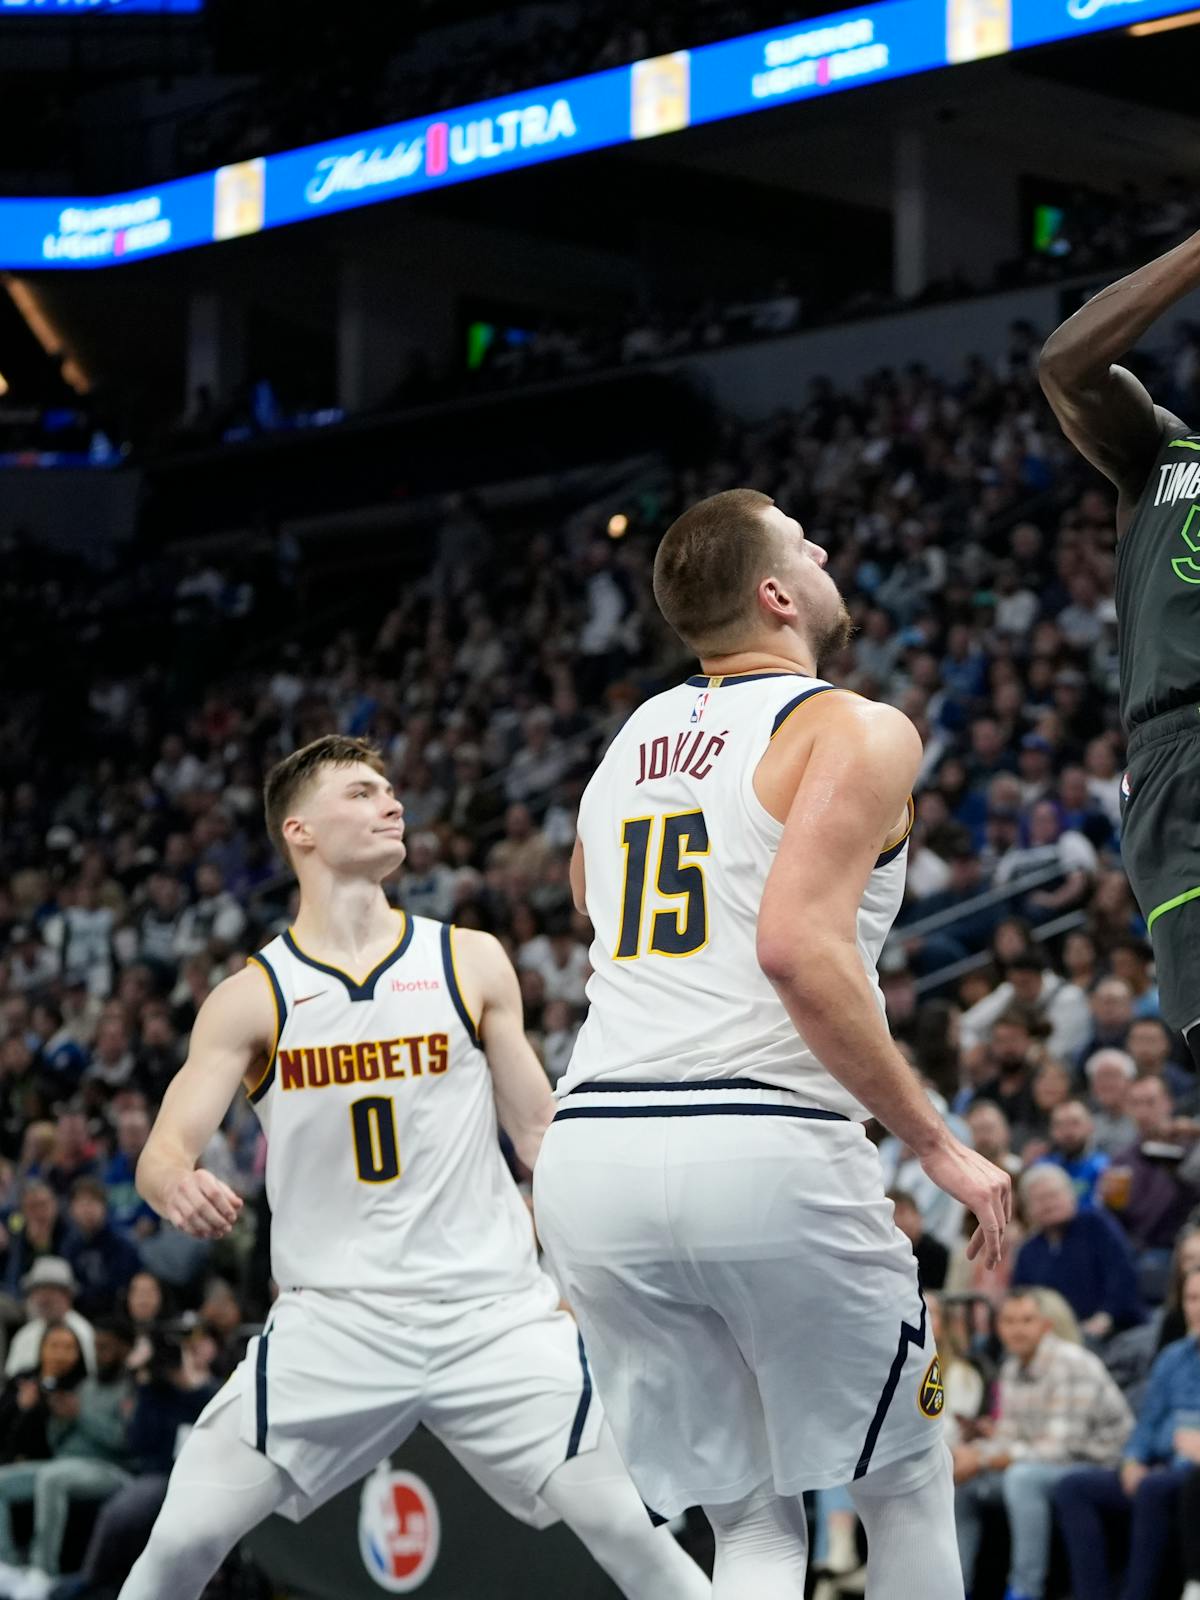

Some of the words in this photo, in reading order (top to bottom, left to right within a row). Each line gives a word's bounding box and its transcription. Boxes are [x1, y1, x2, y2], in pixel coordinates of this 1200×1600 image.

[450, 99, 576, 165] ULTRA
[635, 729, 729, 786] JOKIĆ
[612, 808, 711, 961] 15
[391, 979, 439, 993] ibotta
[278, 1033, 449, 1091] NUGGETS
[350, 1095, 400, 1185] 0
